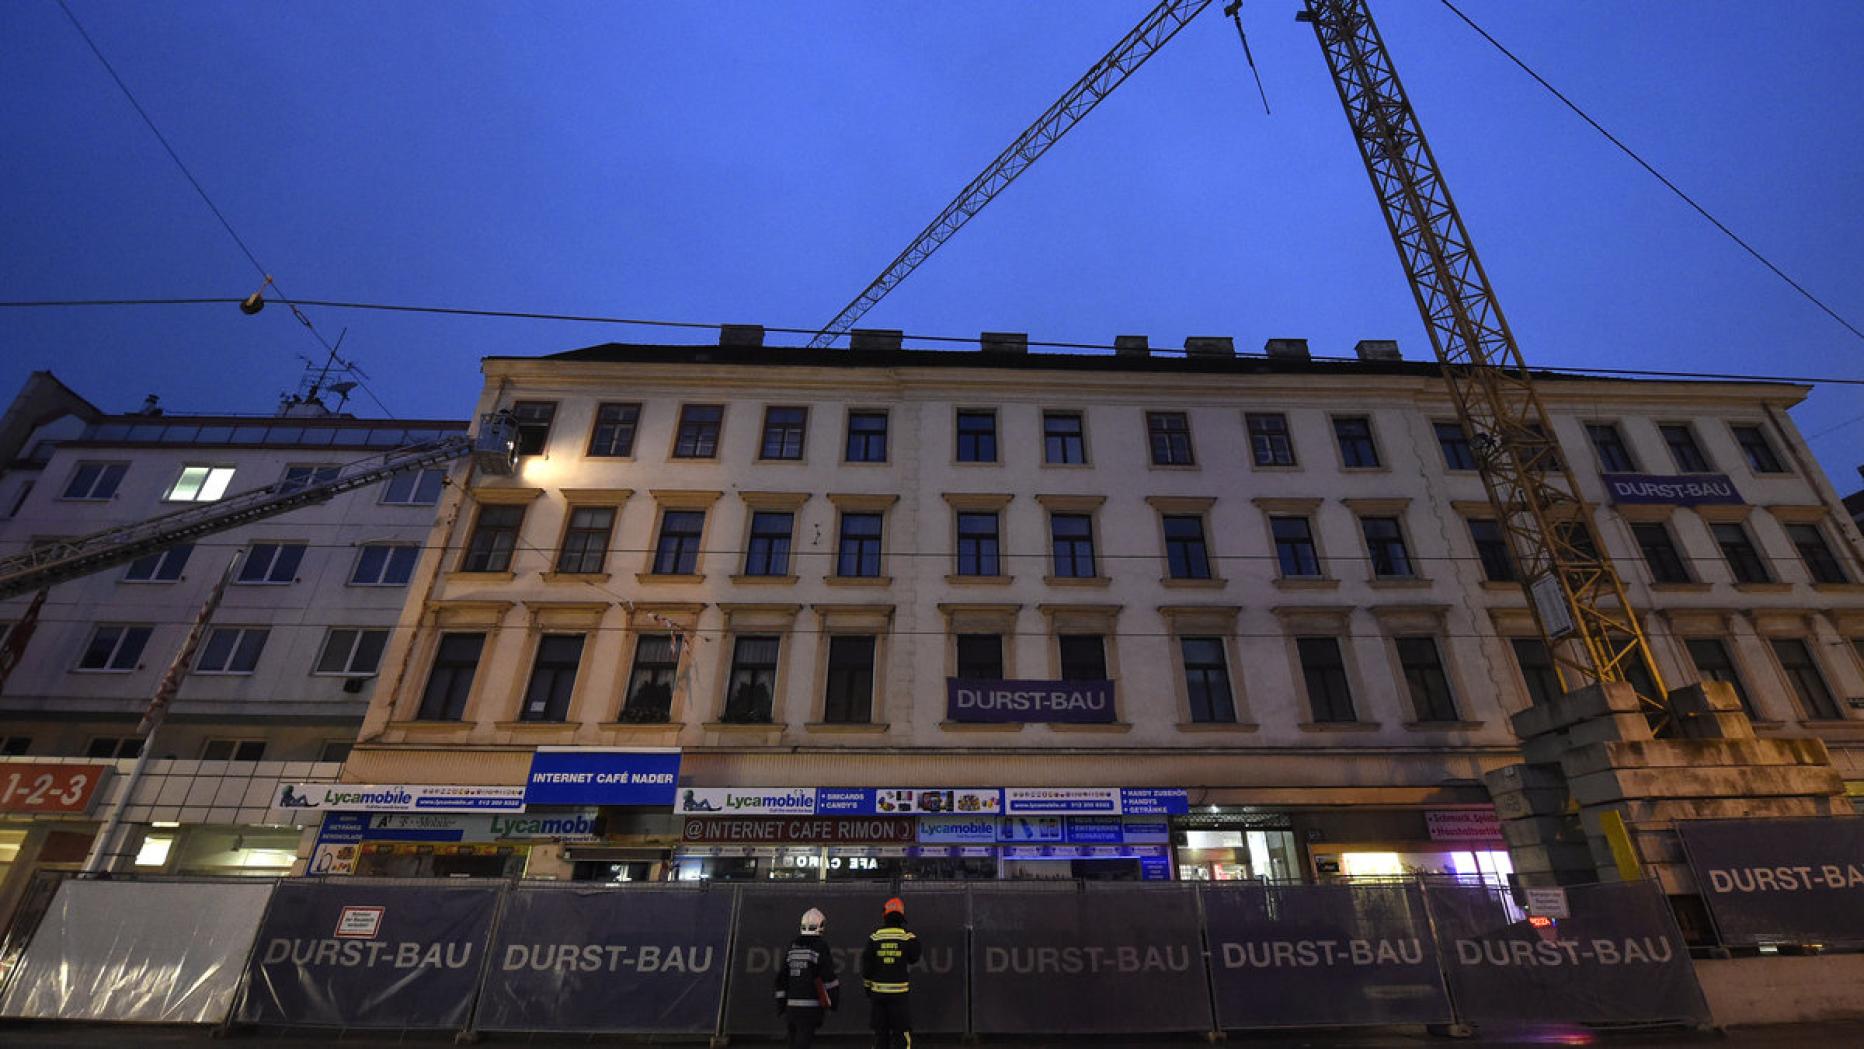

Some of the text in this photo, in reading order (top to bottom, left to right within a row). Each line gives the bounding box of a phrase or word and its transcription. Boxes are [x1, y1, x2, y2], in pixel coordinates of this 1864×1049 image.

[1614, 482, 1732, 498] DURST-BAU
[957, 689, 1105, 710] DURST-BAU
[2, 773, 87, 805] 1-2-3
[533, 771, 674, 784] INTERNET CAFÉ NADER
[324, 788, 412, 805] Lycamobile
[726, 793, 813, 809] Lycamobile
[705, 821, 784, 839] INTERNET
[789, 821, 832, 839] CAFE
[838, 821, 895, 839] RIMON
[920, 822, 993, 836] Lycamobile
[1708, 864, 1864, 893] DURST-BA
[263, 938, 472, 968] DURST-BAU
[502, 944, 713, 973] DURST-BAU
[985, 945, 1190, 973] DURST-BAU
[1221, 937, 1424, 968] DURST-BAU
[1456, 935, 1672, 966] DURST-BAU
